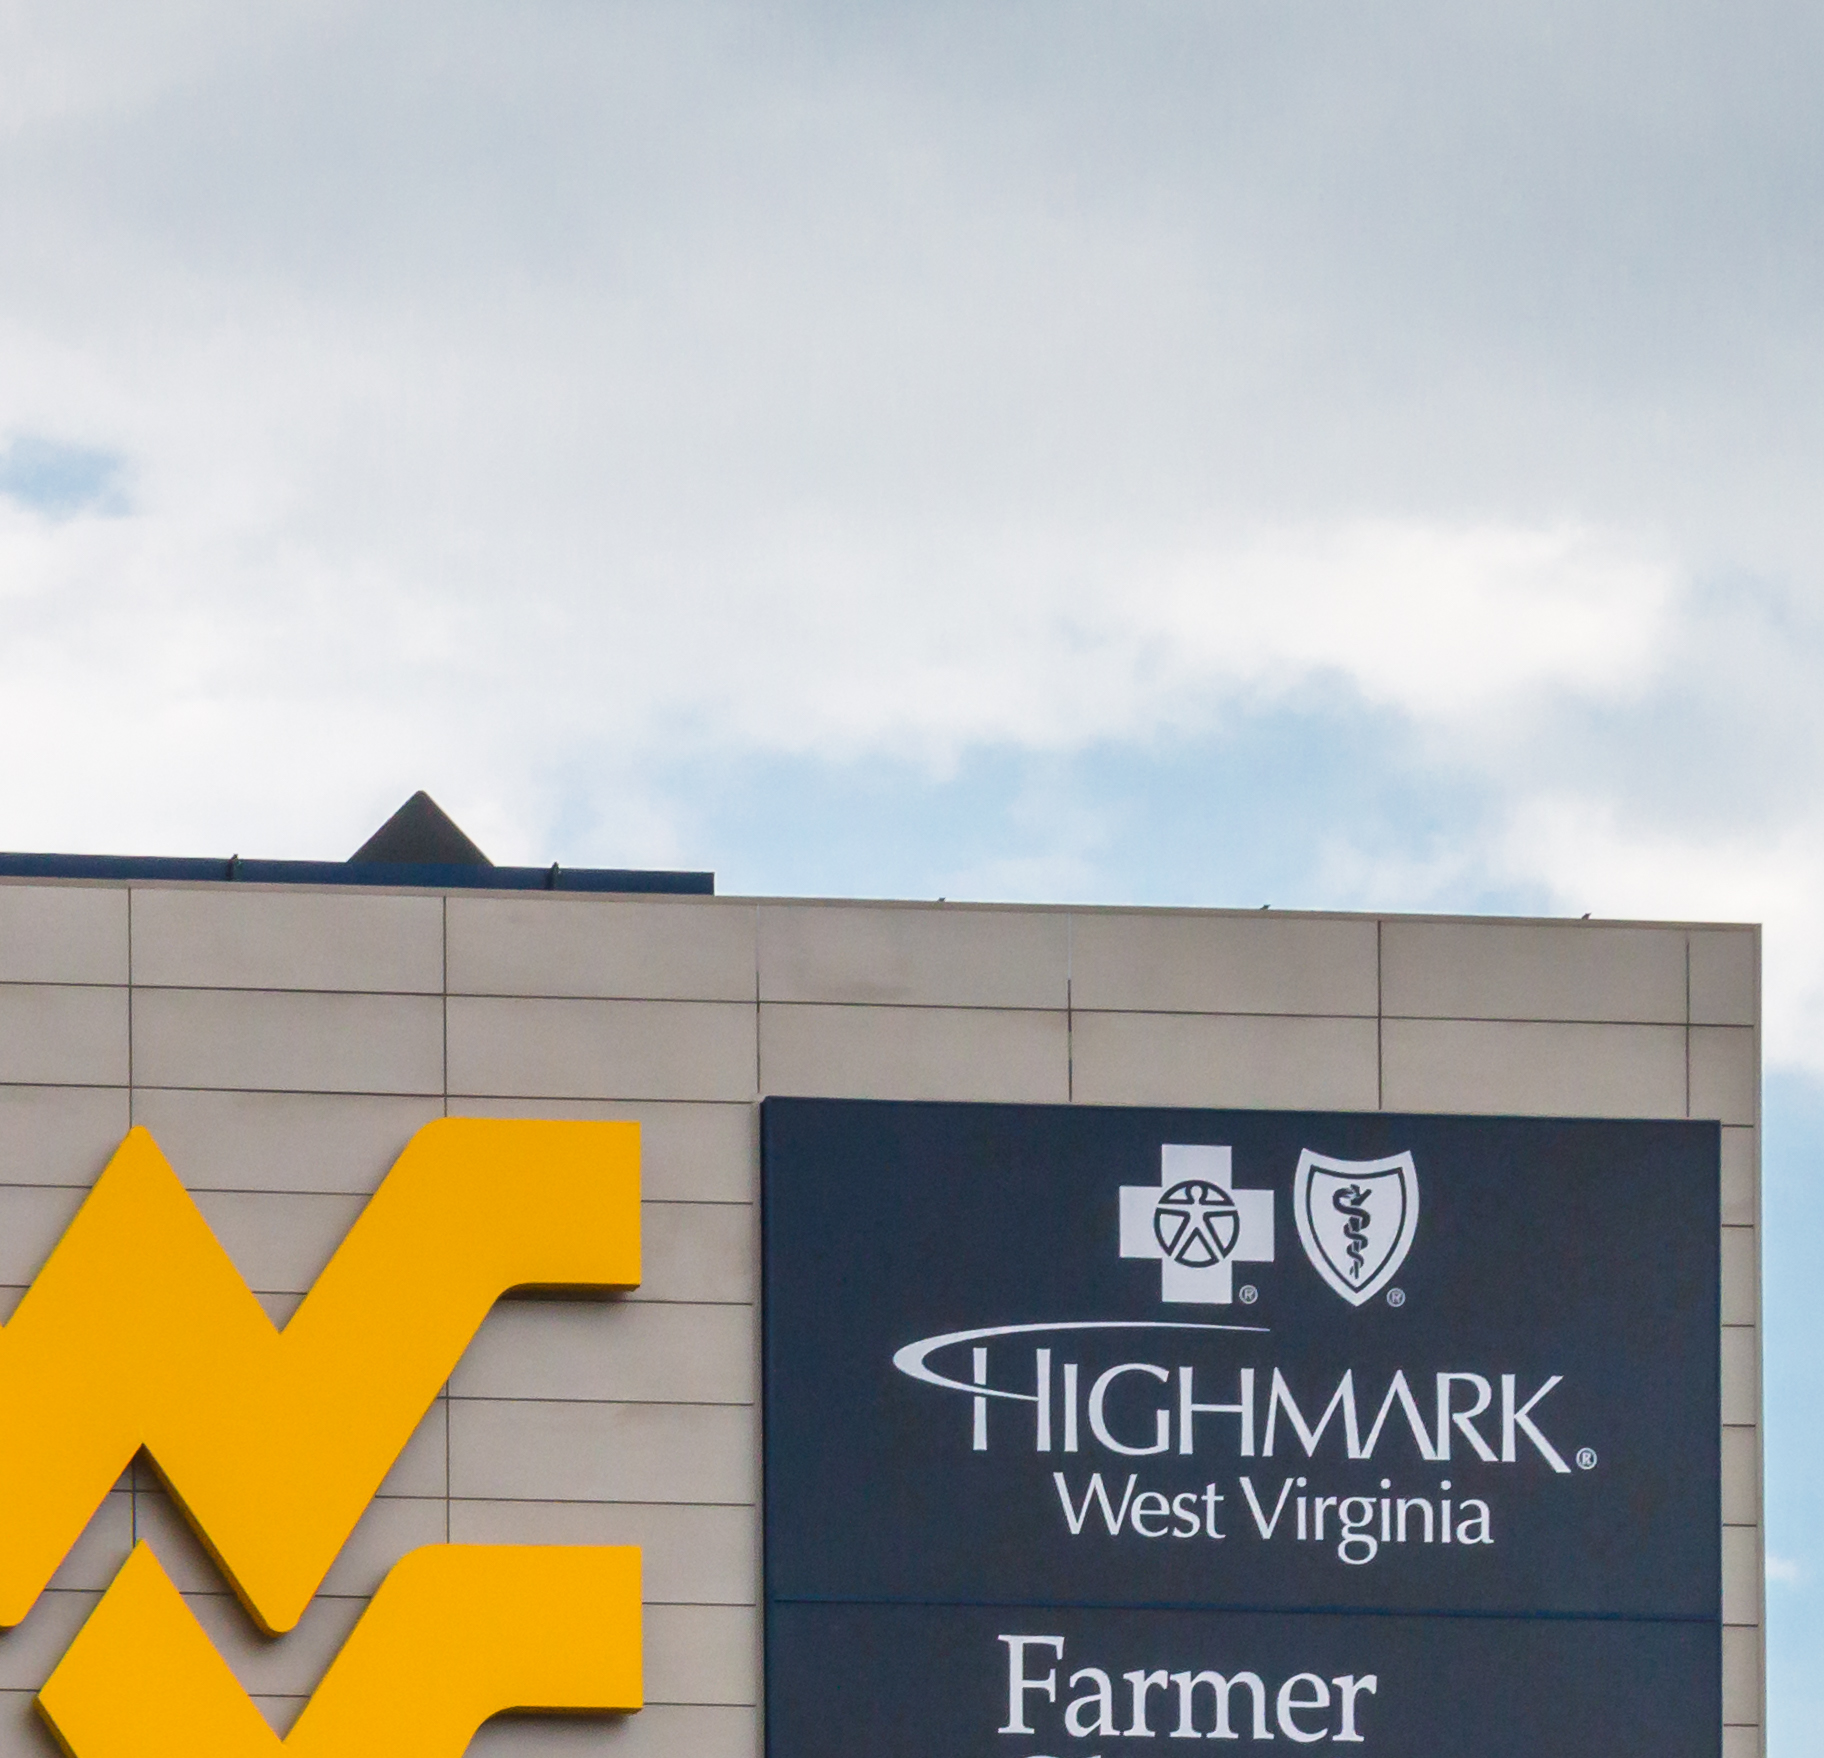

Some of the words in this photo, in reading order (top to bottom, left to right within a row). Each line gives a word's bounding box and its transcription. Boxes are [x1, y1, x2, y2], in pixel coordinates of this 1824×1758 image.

[1053, 1471, 1226, 1539] West
[1239, 1476, 1495, 1565] Virginia
[997, 1634, 1378, 1743] Farmer
